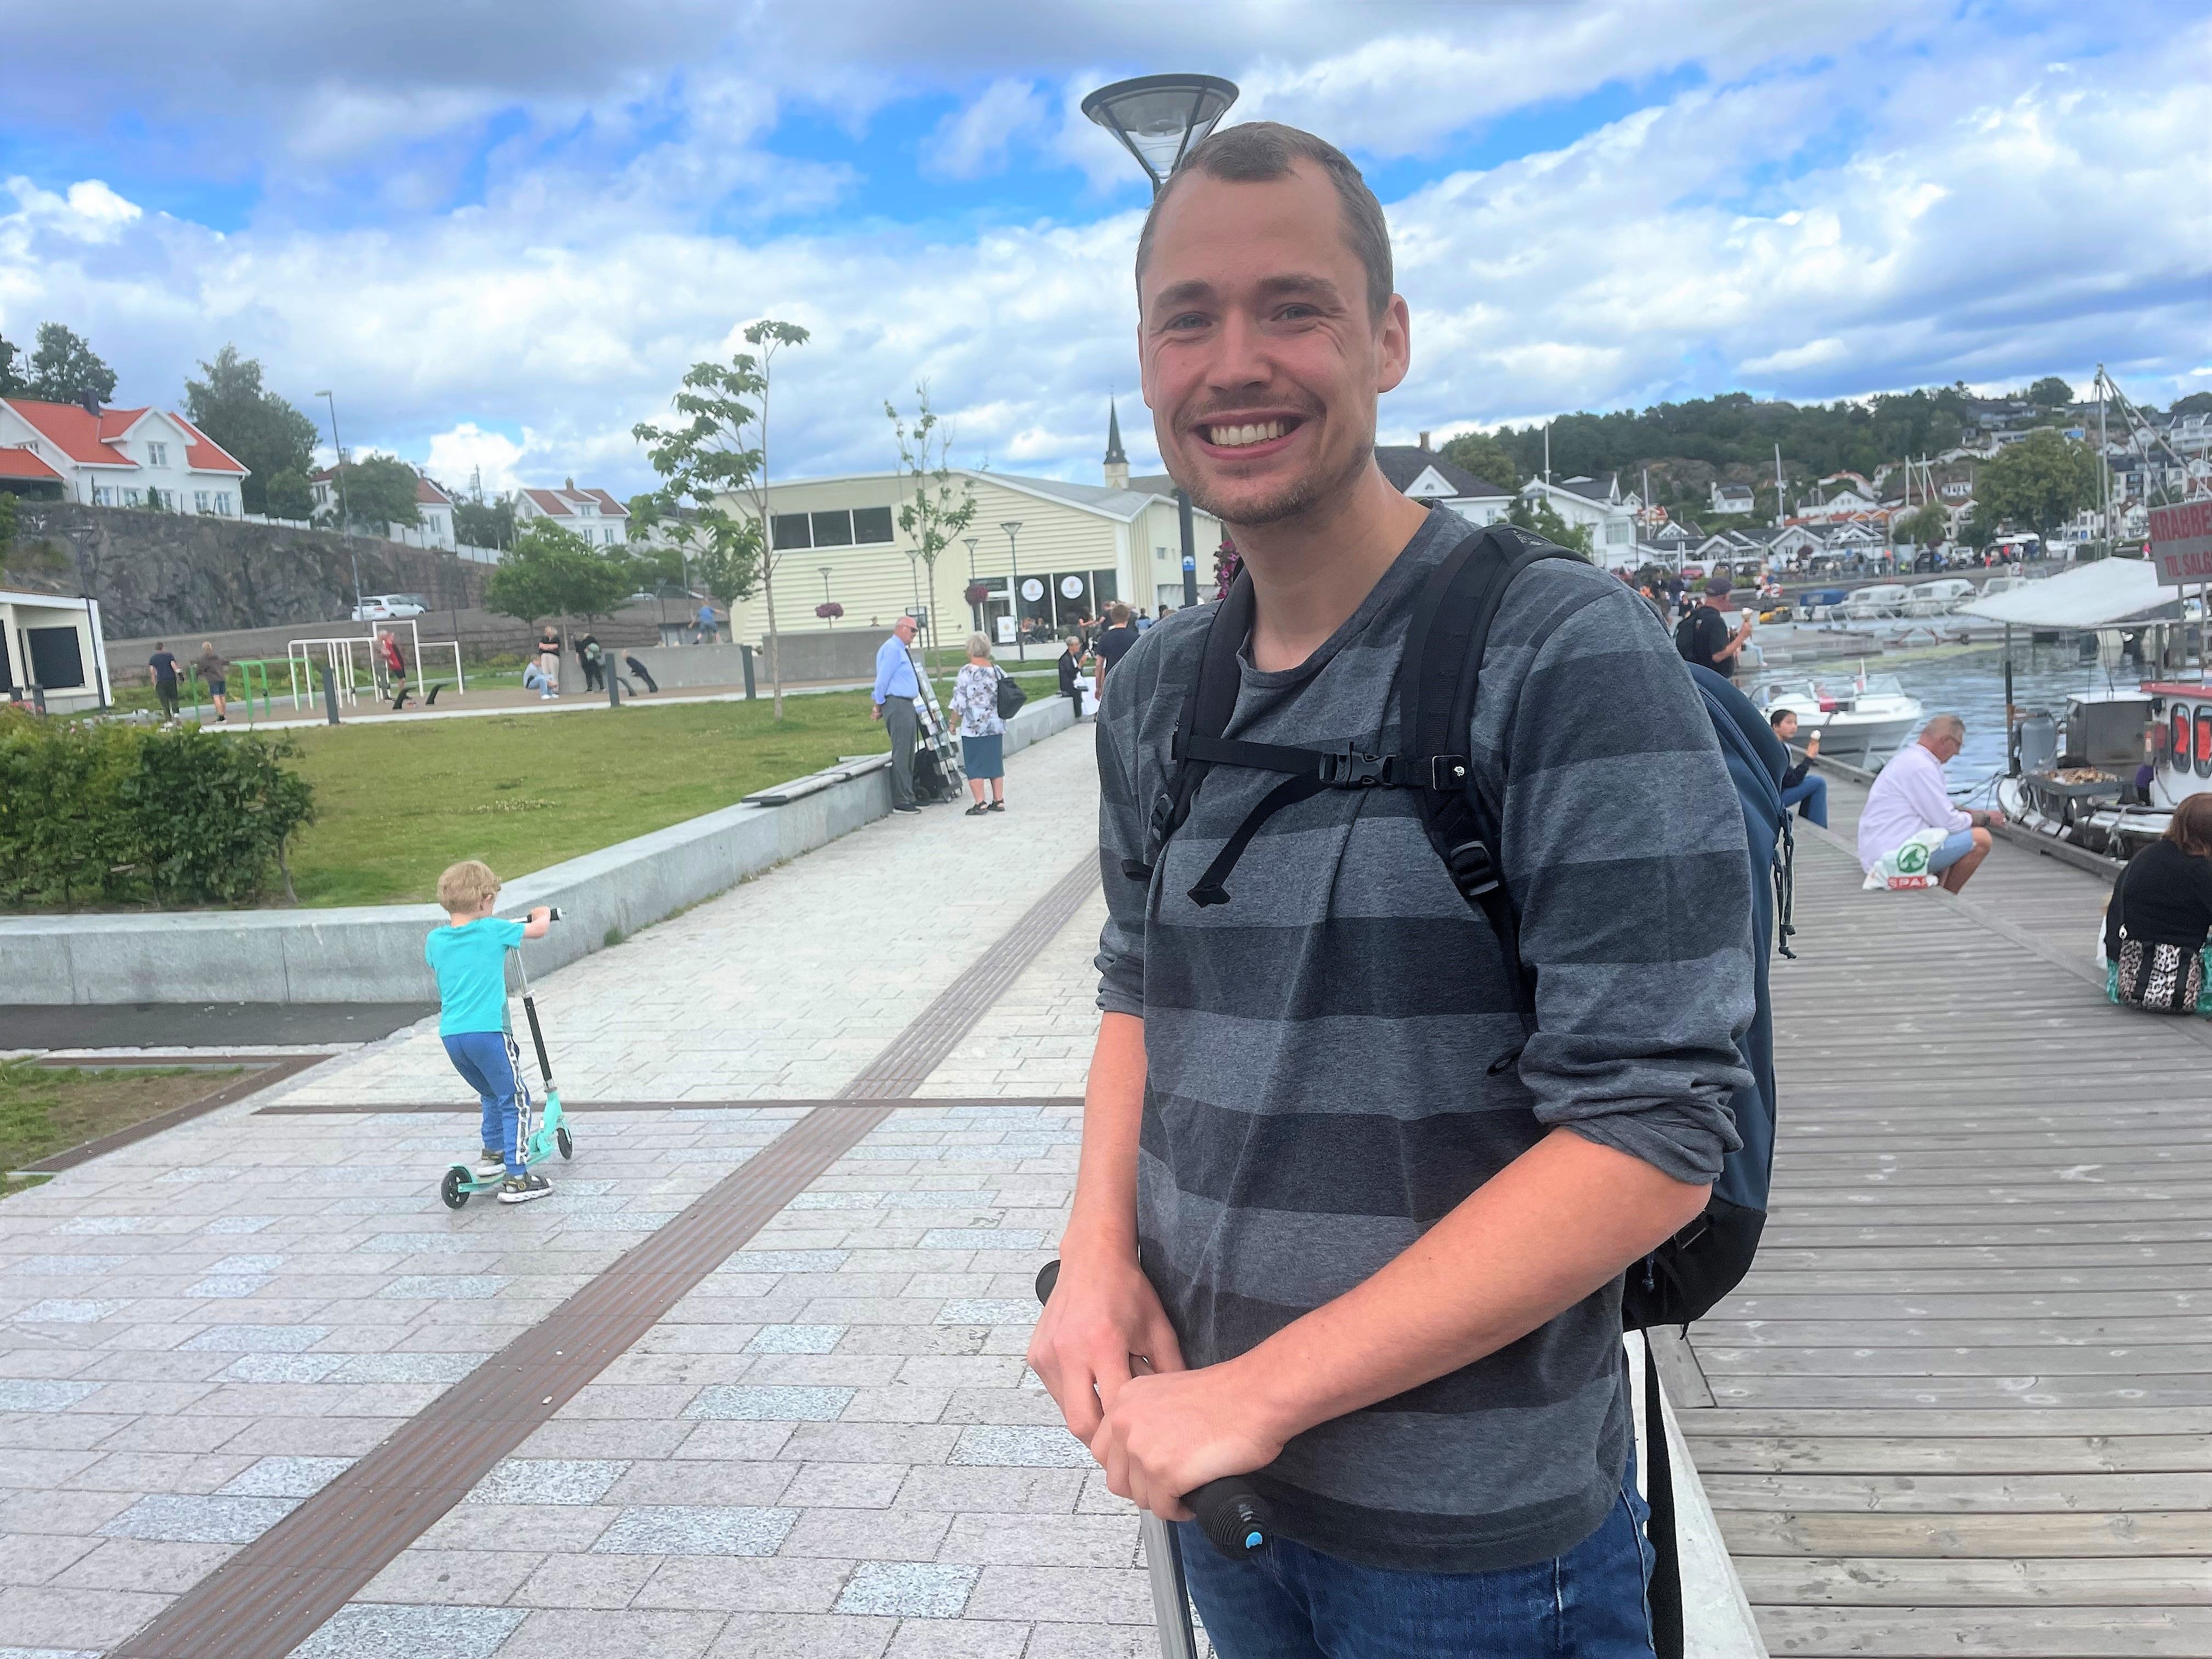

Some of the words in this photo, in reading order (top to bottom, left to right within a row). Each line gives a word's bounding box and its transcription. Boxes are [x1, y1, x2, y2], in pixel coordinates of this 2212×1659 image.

[2148, 503, 2212, 542] KRABBE
[2164, 555, 2182, 577] TIL
[2182, 550, 2212, 575] SALG
